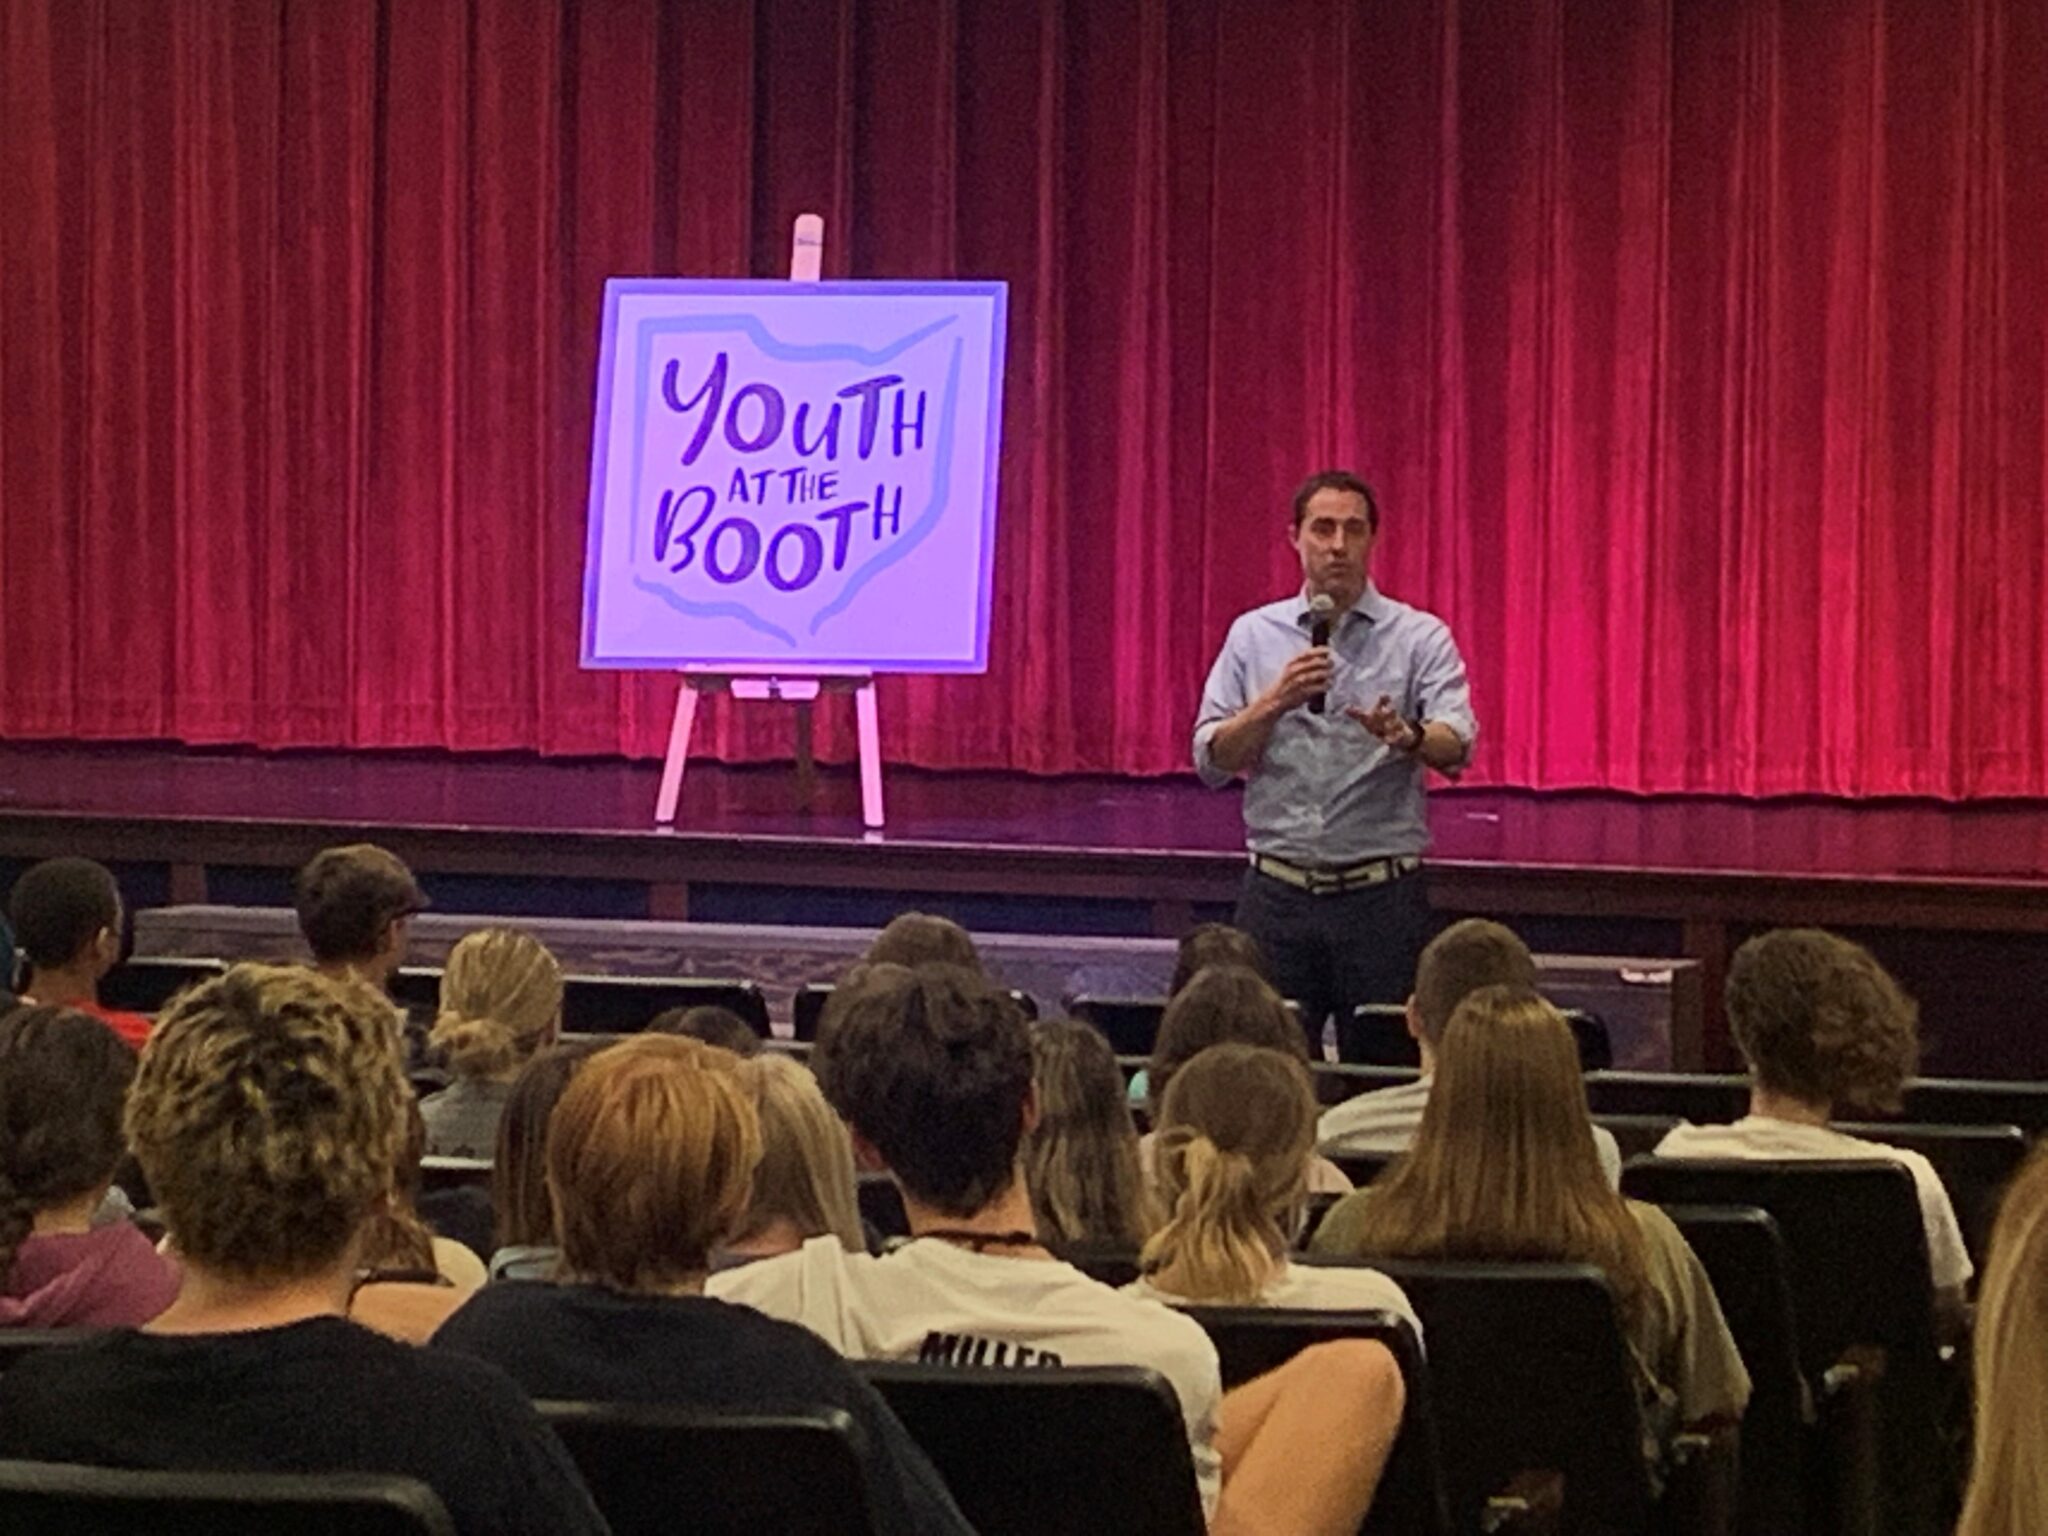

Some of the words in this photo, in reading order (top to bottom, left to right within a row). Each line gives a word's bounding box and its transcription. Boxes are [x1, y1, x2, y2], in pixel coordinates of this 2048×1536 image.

[661, 352, 926, 466] YOUTH
[653, 483, 902, 592] BOOTH
[728, 467, 776, 505] AT
[778, 466, 840, 504] THE
